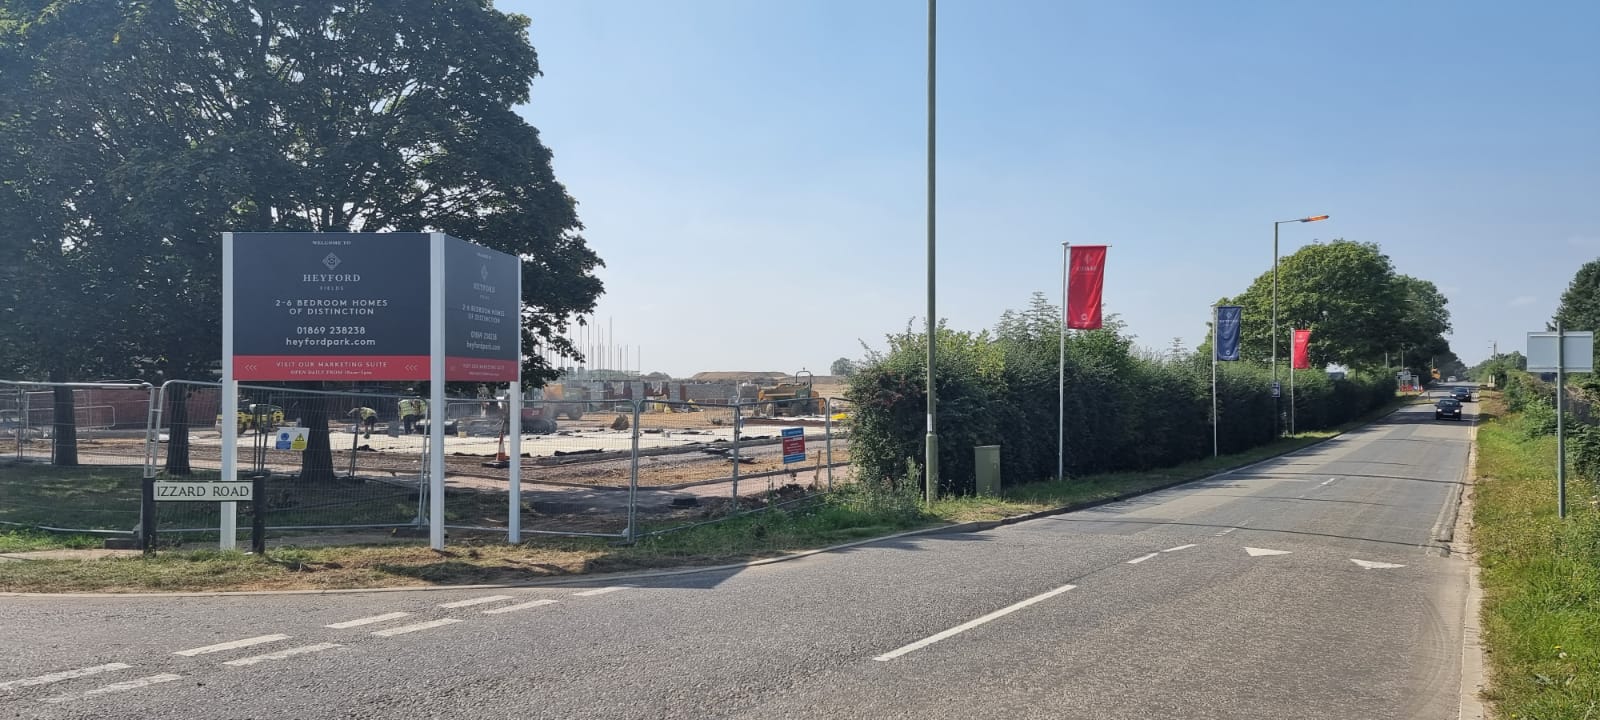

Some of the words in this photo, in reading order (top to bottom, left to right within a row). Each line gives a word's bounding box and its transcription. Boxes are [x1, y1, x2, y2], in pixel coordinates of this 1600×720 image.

[303, 273, 361, 282] HEYFORD
[275, 299, 293, 307] 2-6
[297, 299, 347, 307] BEDROOM
[352, 299, 388, 307] HOMES
[289, 307, 303, 315] OF
[307, 307, 375, 315] DISTINCTION
[297, 326, 325, 335] 01869
[329, 326, 366, 335] 238238
[285, 337, 376, 348] heyfordpark.com
[157, 486, 206, 497] IZZARD
[212, 486, 249, 497] ROAD
